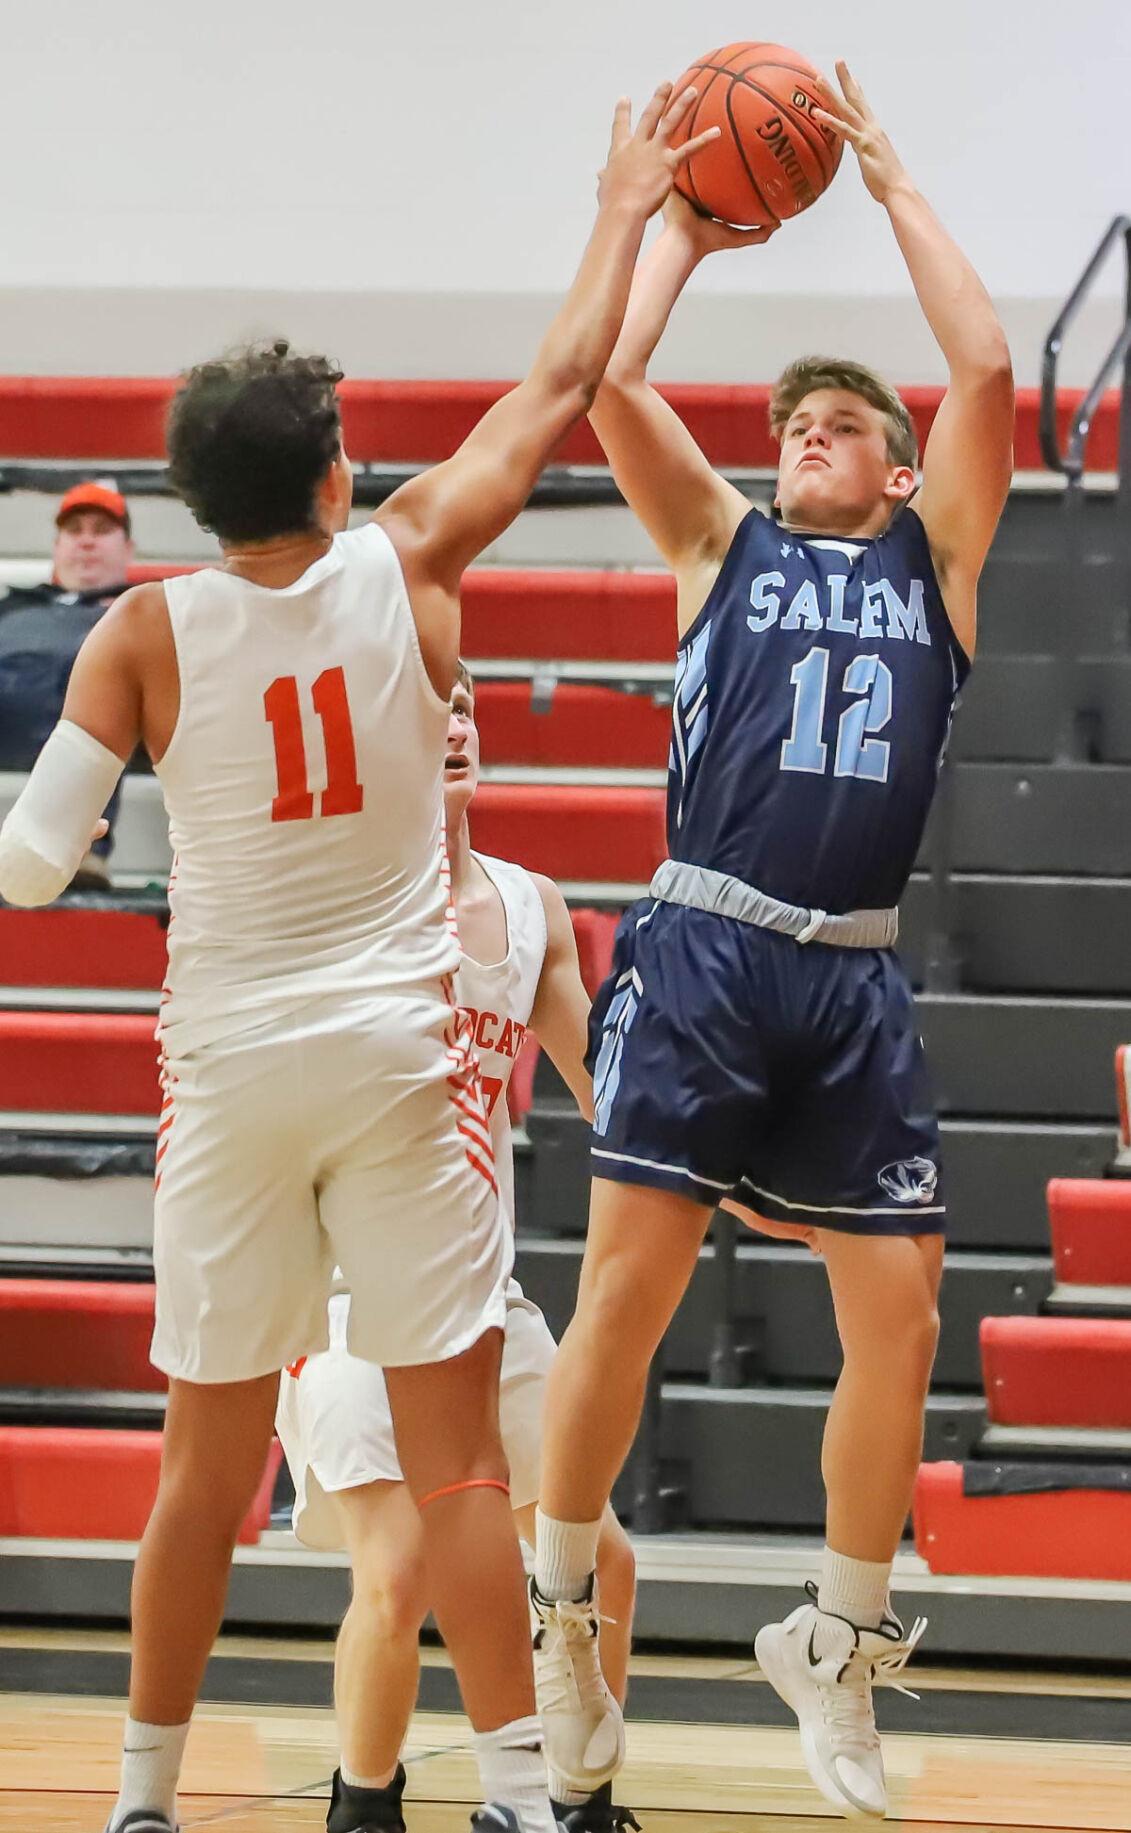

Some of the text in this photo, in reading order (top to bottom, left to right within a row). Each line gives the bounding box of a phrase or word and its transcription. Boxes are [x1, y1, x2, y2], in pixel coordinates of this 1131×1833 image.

[747, 571, 931, 646] SALEM
[264, 666, 363, 822] 11
[779, 646, 892, 783] 12
